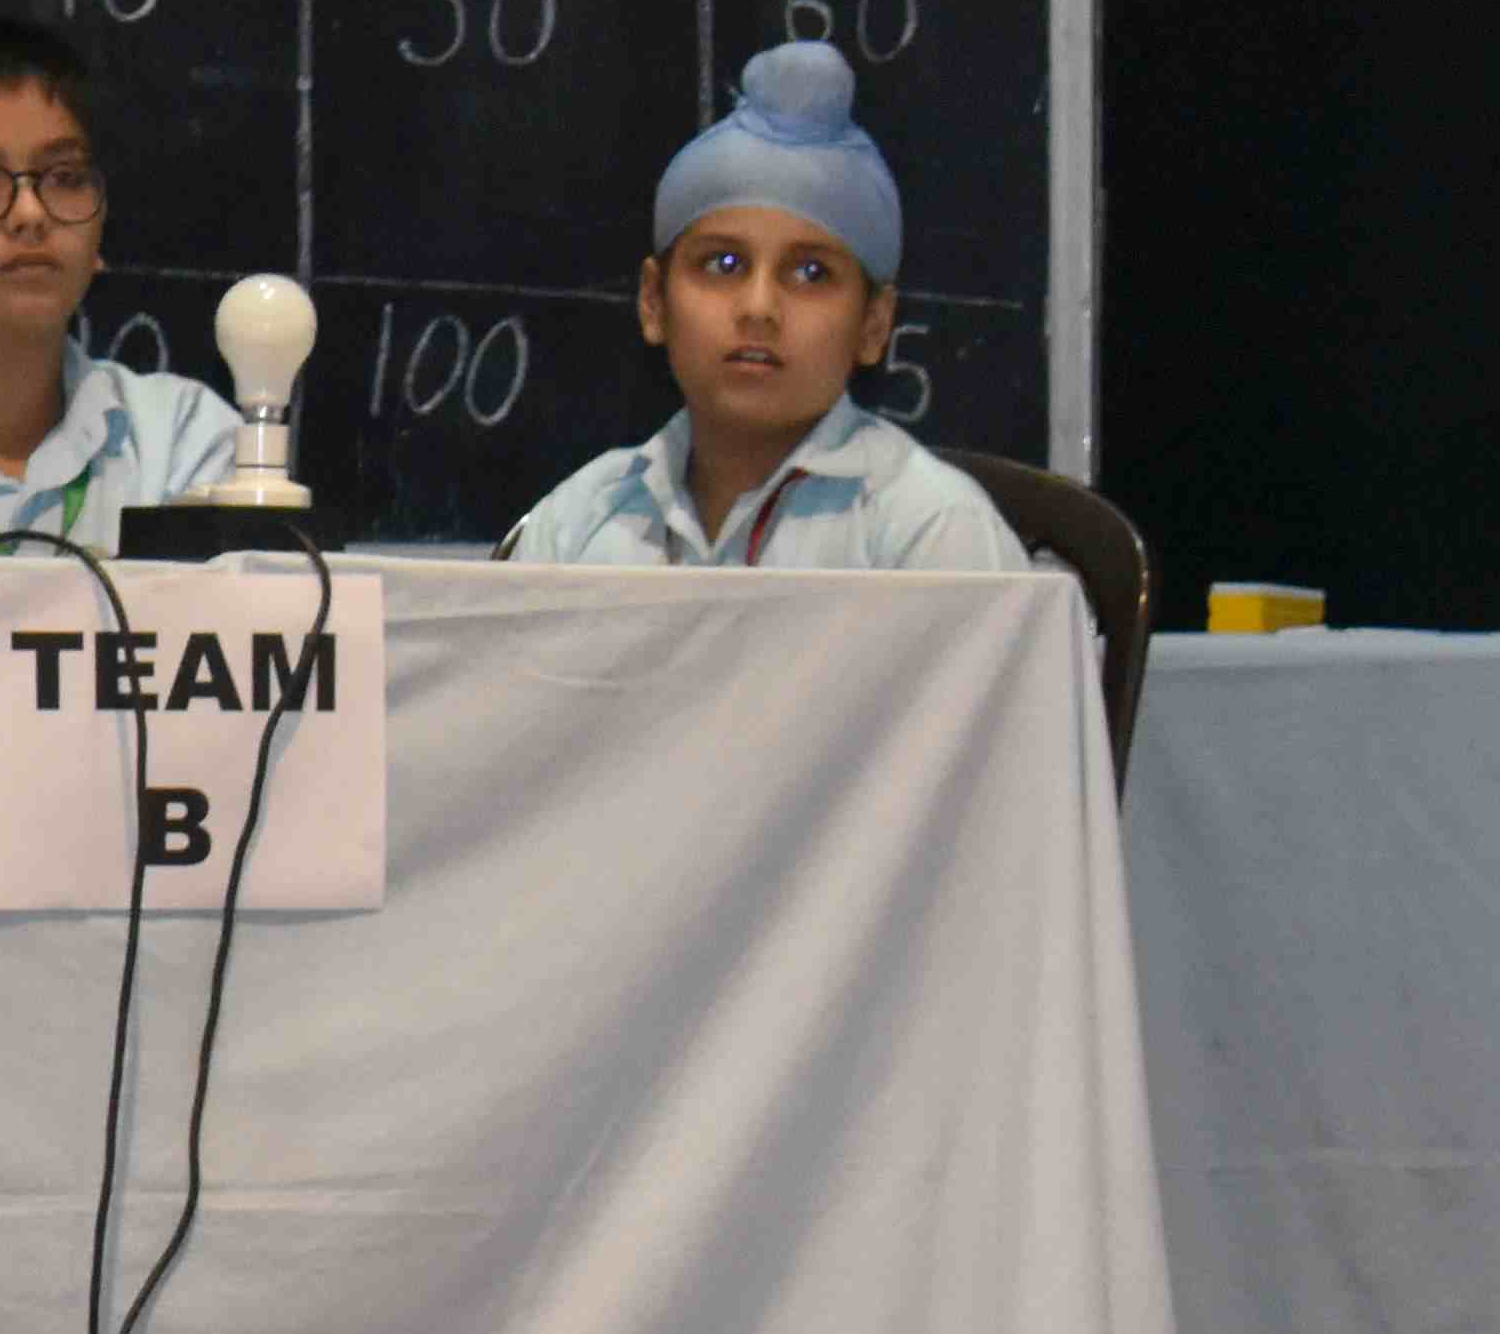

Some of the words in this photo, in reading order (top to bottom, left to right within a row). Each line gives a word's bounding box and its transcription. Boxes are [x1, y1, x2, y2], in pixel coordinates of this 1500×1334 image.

[369, 301, 529, 427] 100
[877, 323, 932, 427] 5
[10, 630, 337, 713] TEAM
[139, 786, 213, 868] B
